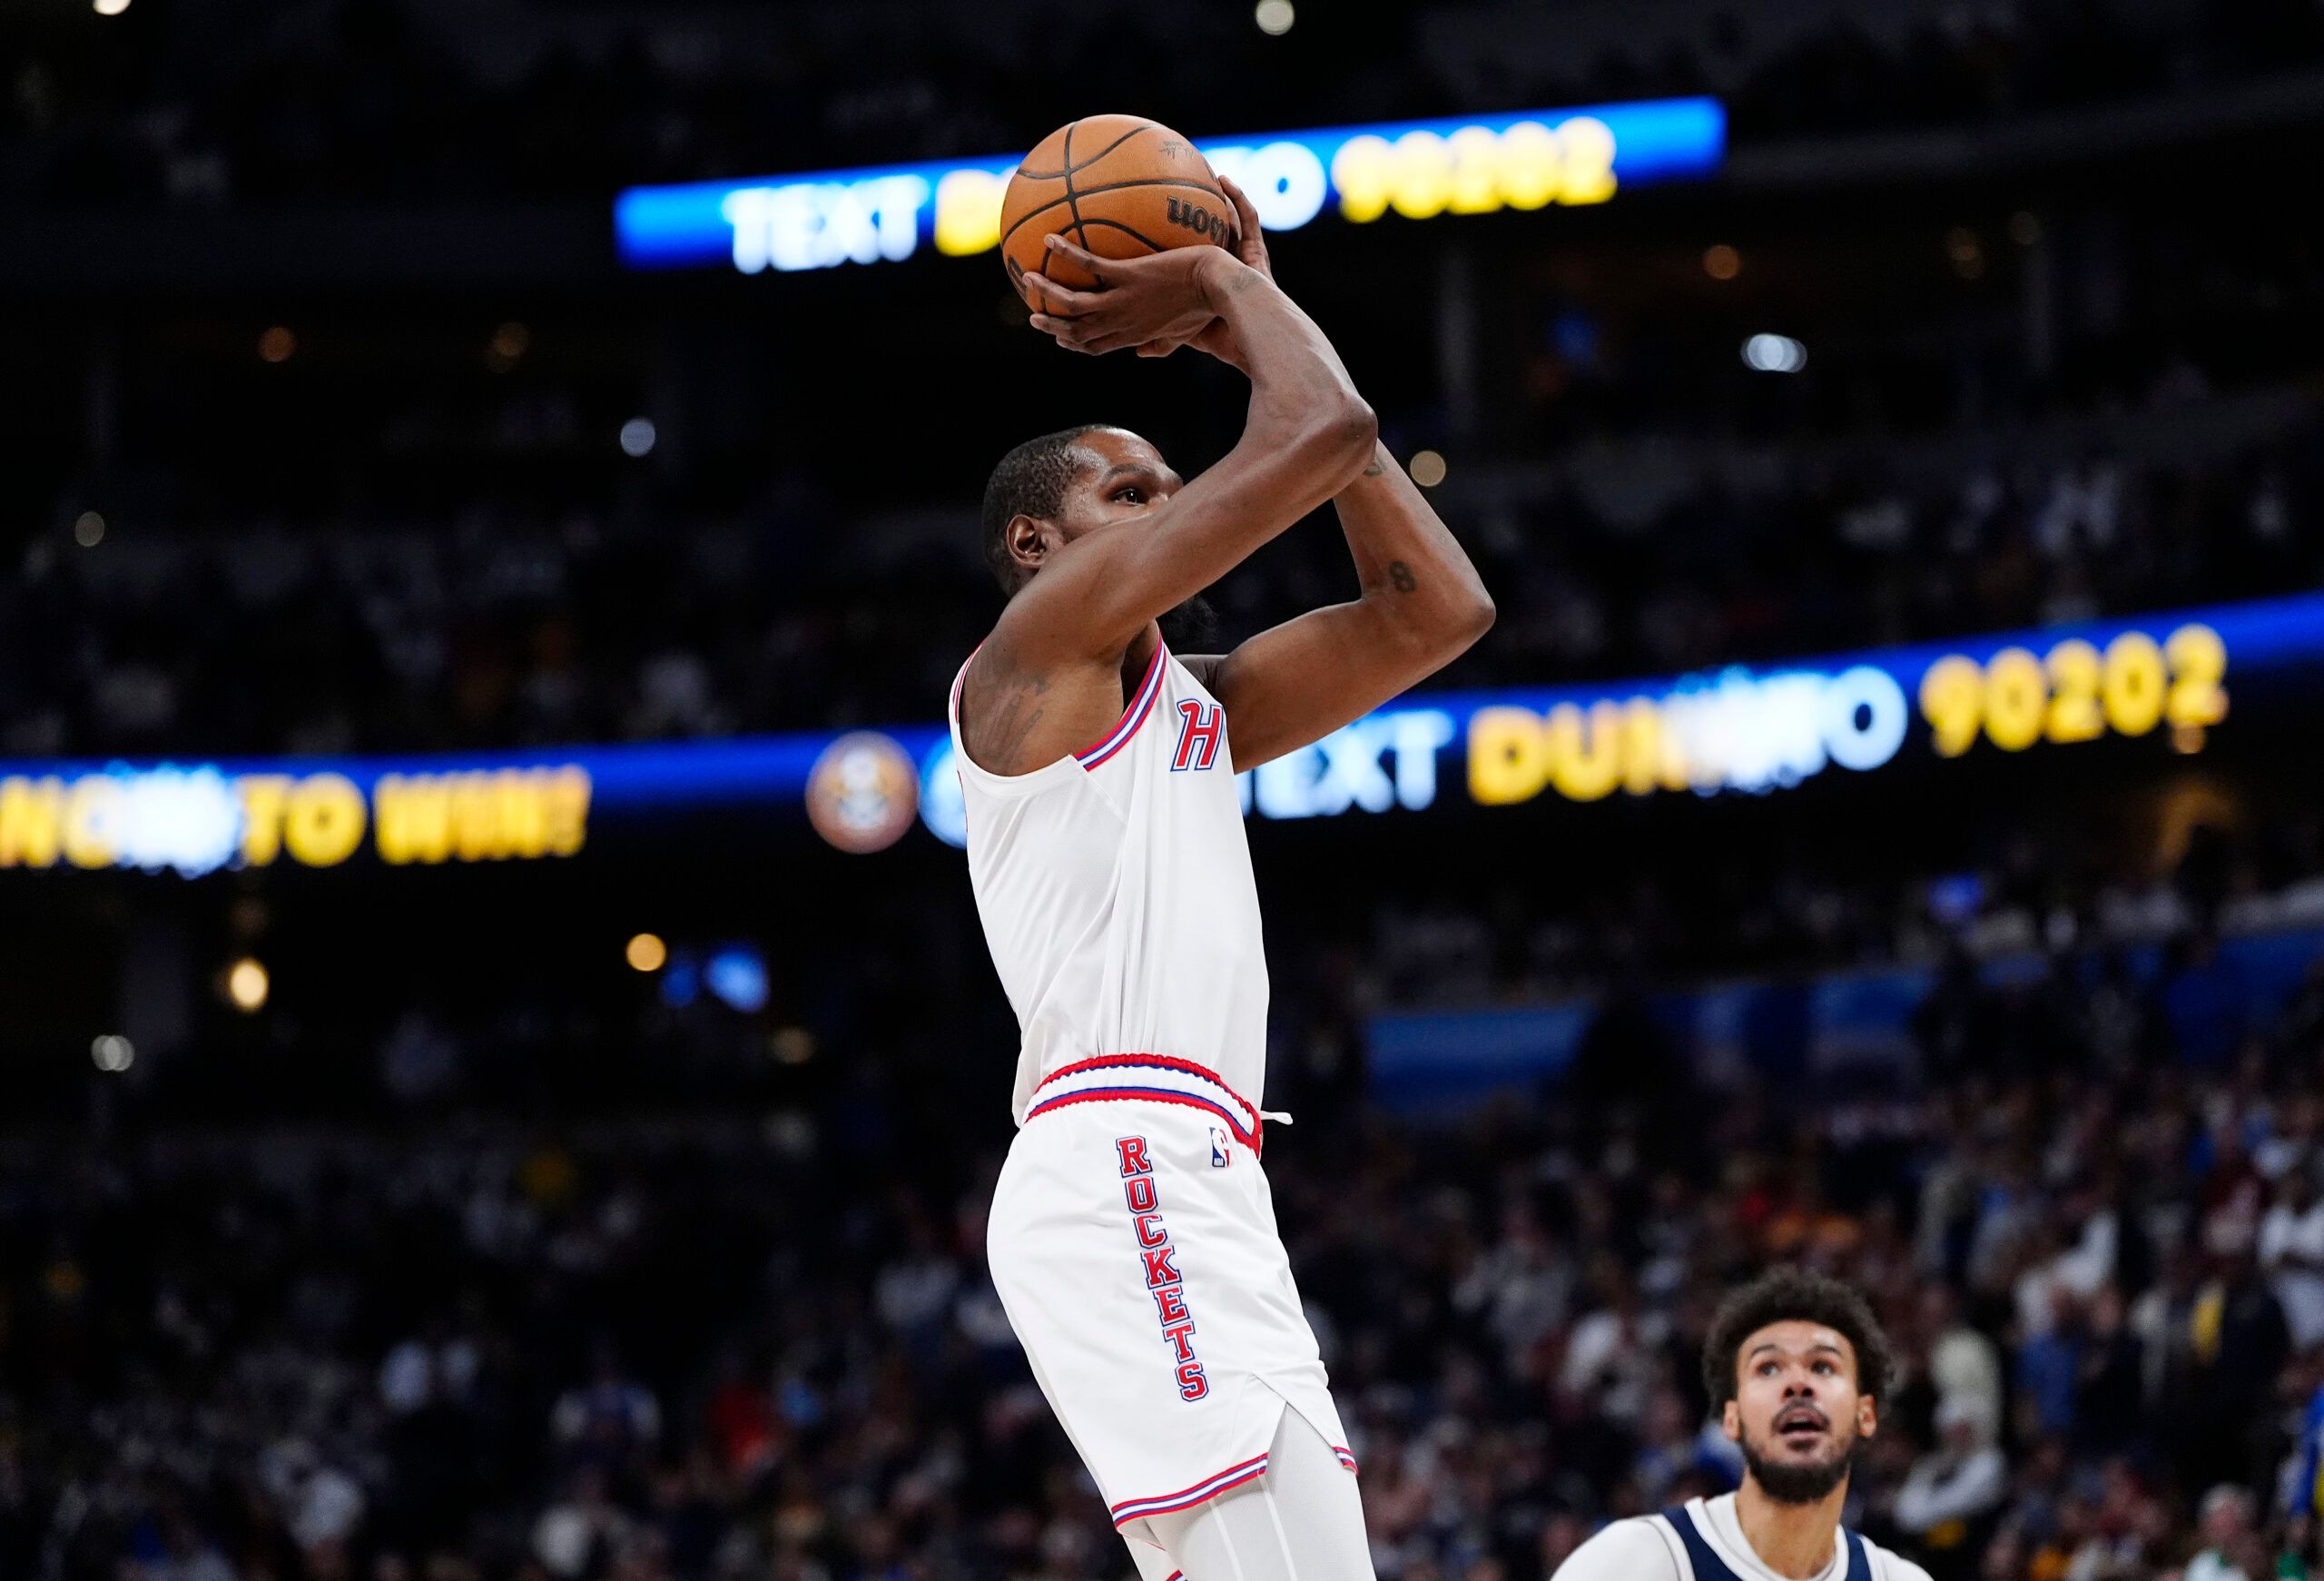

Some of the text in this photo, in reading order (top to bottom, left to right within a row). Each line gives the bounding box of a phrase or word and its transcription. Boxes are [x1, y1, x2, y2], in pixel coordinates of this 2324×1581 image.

[1170, 697, 1224, 772] H
[1236, 707, 1457, 820] EXT
[1917, 623, 2230, 758] 90202
[1116, 1135, 1208, 1402] ROCKETS
